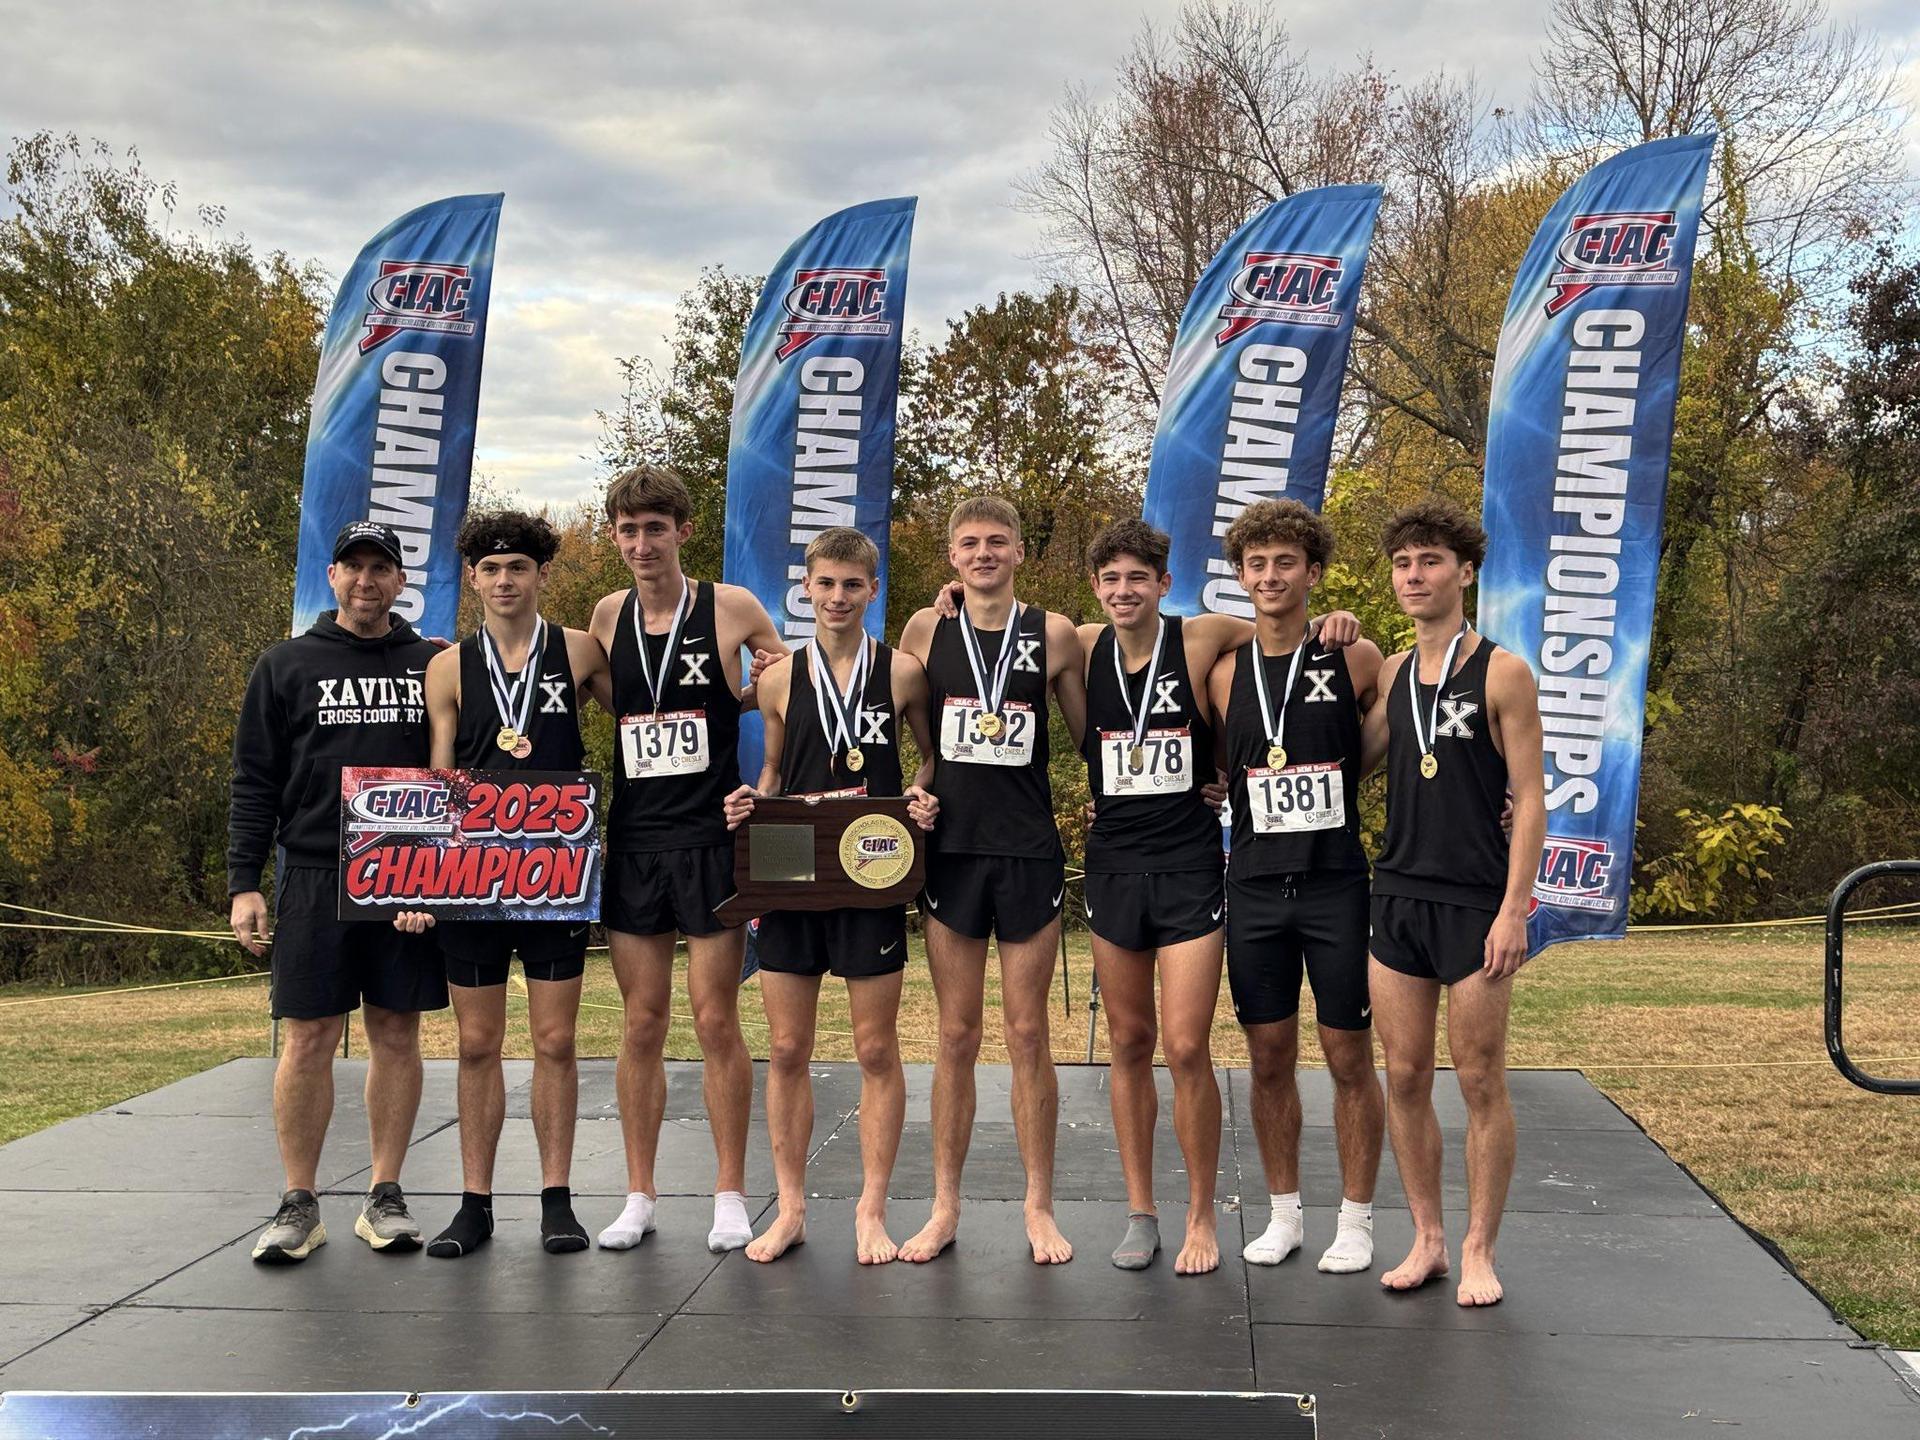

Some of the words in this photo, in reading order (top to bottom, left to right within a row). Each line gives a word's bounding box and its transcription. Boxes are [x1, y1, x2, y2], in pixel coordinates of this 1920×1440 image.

[1574, 224, 1678, 265] CIAC
[385, 274, 473, 312] CIAC
[798, 280, 888, 315] CIAC
[1246, 265, 1343, 305] CIAC
[1538, 309, 1645, 814] CHAMPIONSHIPS
[679, 653, 711, 685] X
[1013, 640, 1041, 673] X
[317, 678, 424, 707] XAVIER
[538, 682, 568, 713] X
[1151, 680, 1181, 715] X
[1304, 669, 1338, 703] X
[318, 708, 362, 725] CROSS
[363, 708, 424, 723] COUNRY
[860, 711, 891, 745] X
[1435, 699, 1478, 739] X
[630, 720, 699, 759] 1379
[365, 789, 450, 818] CIAC
[461, 783, 595, 839] 2025
[1258, 773, 1332, 814] 1381
[863, 838, 898, 852] CIAC
[346, 846, 592, 905] CHAMPION
[1537, 847, 1614, 890] IAC
